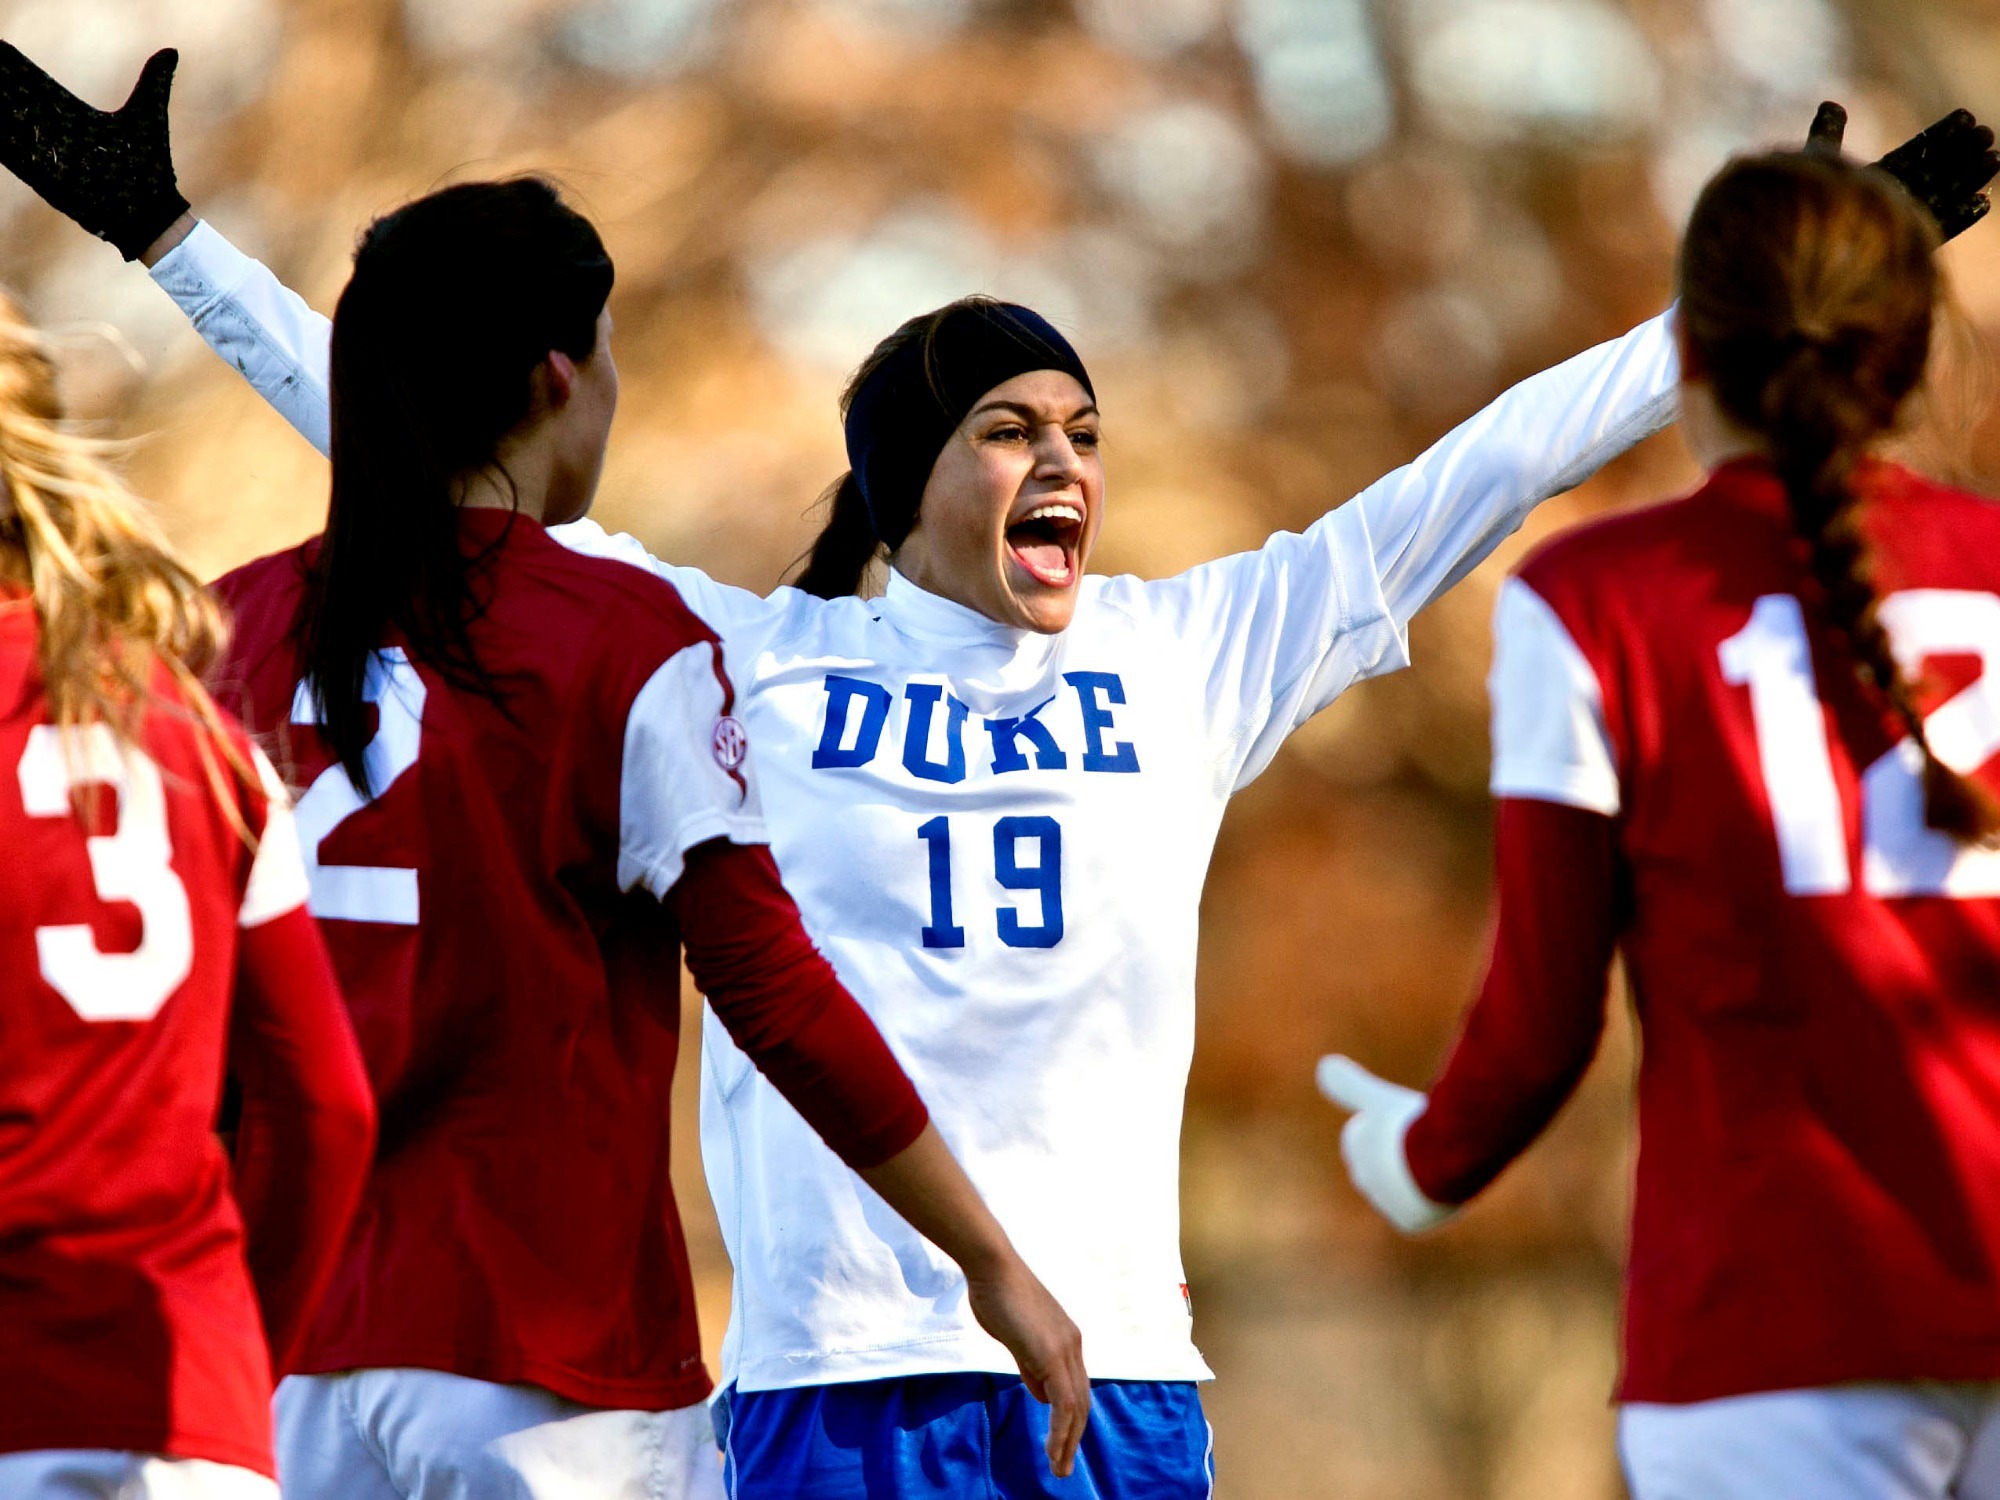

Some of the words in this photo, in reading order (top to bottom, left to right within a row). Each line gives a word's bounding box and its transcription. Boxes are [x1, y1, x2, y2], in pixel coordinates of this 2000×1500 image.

[290, 647, 427, 925] 2
[812, 671, 1141, 784] DUKE
[1716, 588, 2000, 897] 12
[17, 723, 195, 1022] 3
[917, 815, 1064, 949] 19
